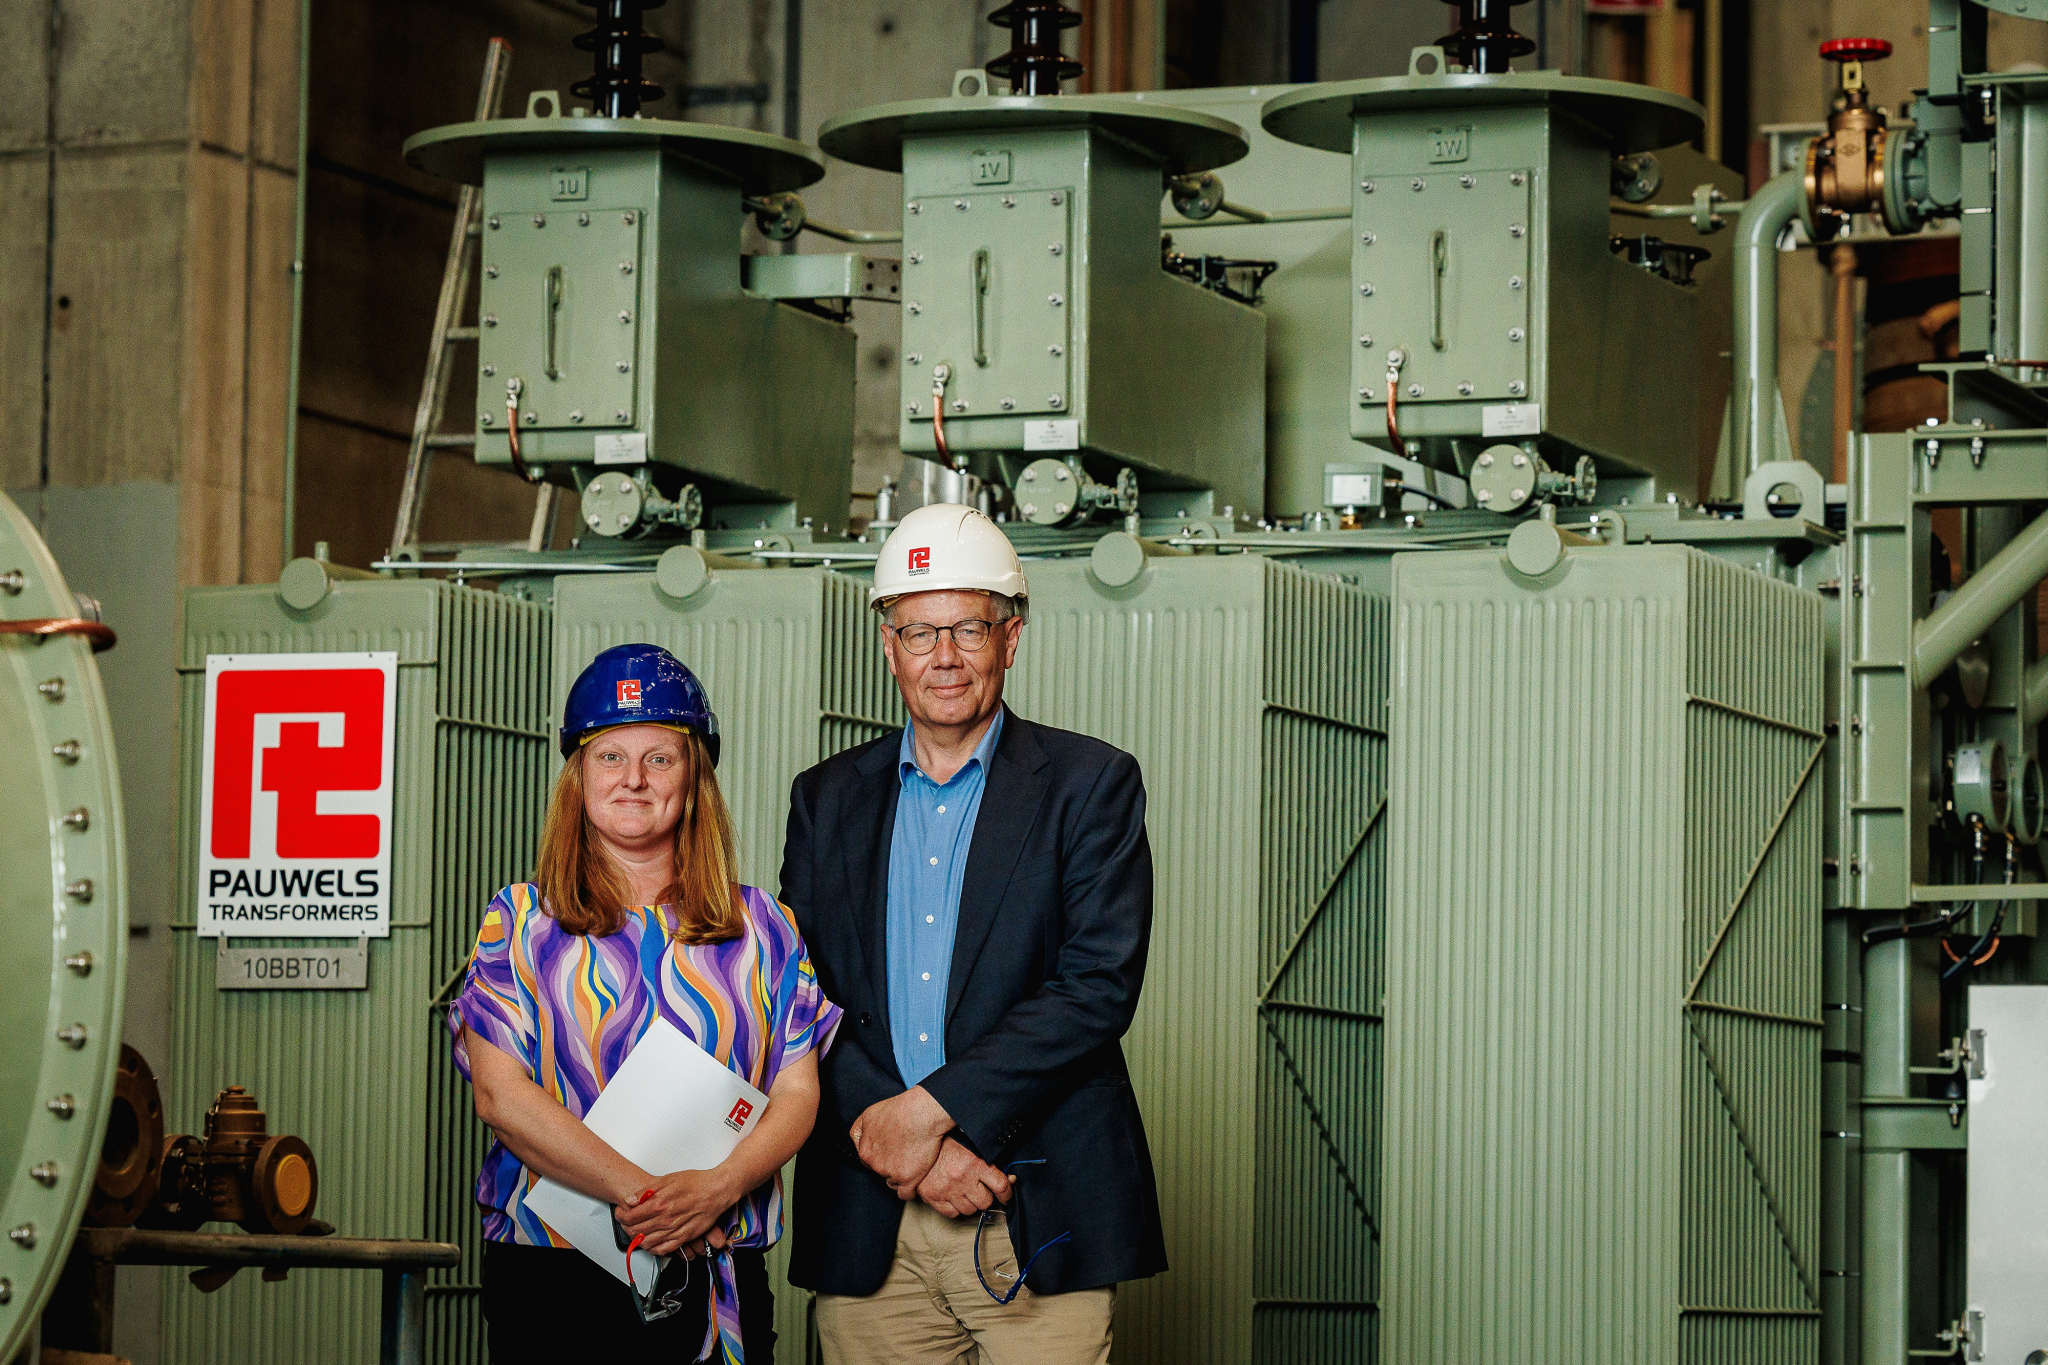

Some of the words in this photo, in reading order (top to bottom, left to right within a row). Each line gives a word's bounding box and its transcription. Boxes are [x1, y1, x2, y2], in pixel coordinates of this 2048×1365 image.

[1436, 139, 1462, 156] 1W
[981, 161, 1000, 178] 1V
[559, 179, 579, 195] 1U
[209, 869, 379, 897] PAUWELS
[209, 904, 378, 921] TRANSFORMERS
[243, 957, 341, 979] 10BBT01
